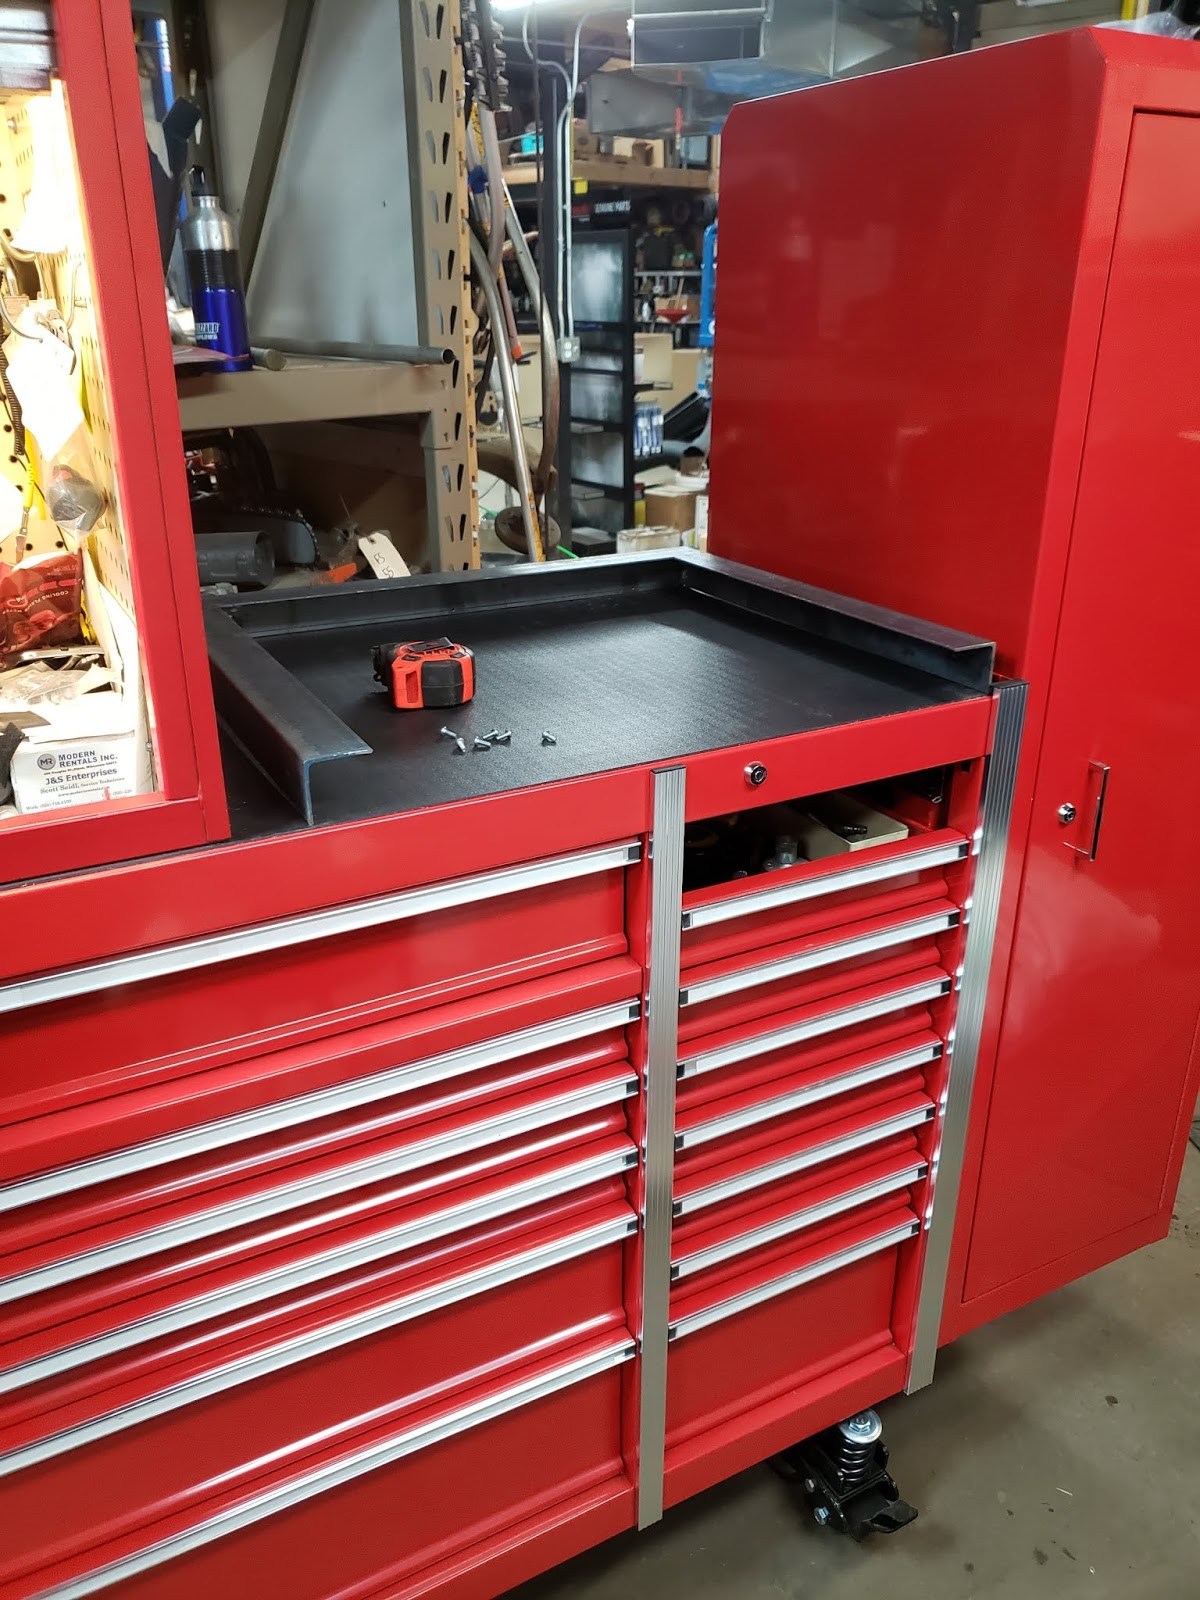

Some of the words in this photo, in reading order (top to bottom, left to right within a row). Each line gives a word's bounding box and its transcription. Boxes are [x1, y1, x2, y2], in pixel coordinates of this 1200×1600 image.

[195, 322, 219, 334] IZZARD
[41, 590, 69, 600] COOLING
[58, 750, 96, 761] MODERN
[60, 757, 98, 768] RENTALS
[45, 776, 64, 785] J&S
[66, 768, 118, 781] Enterprises
